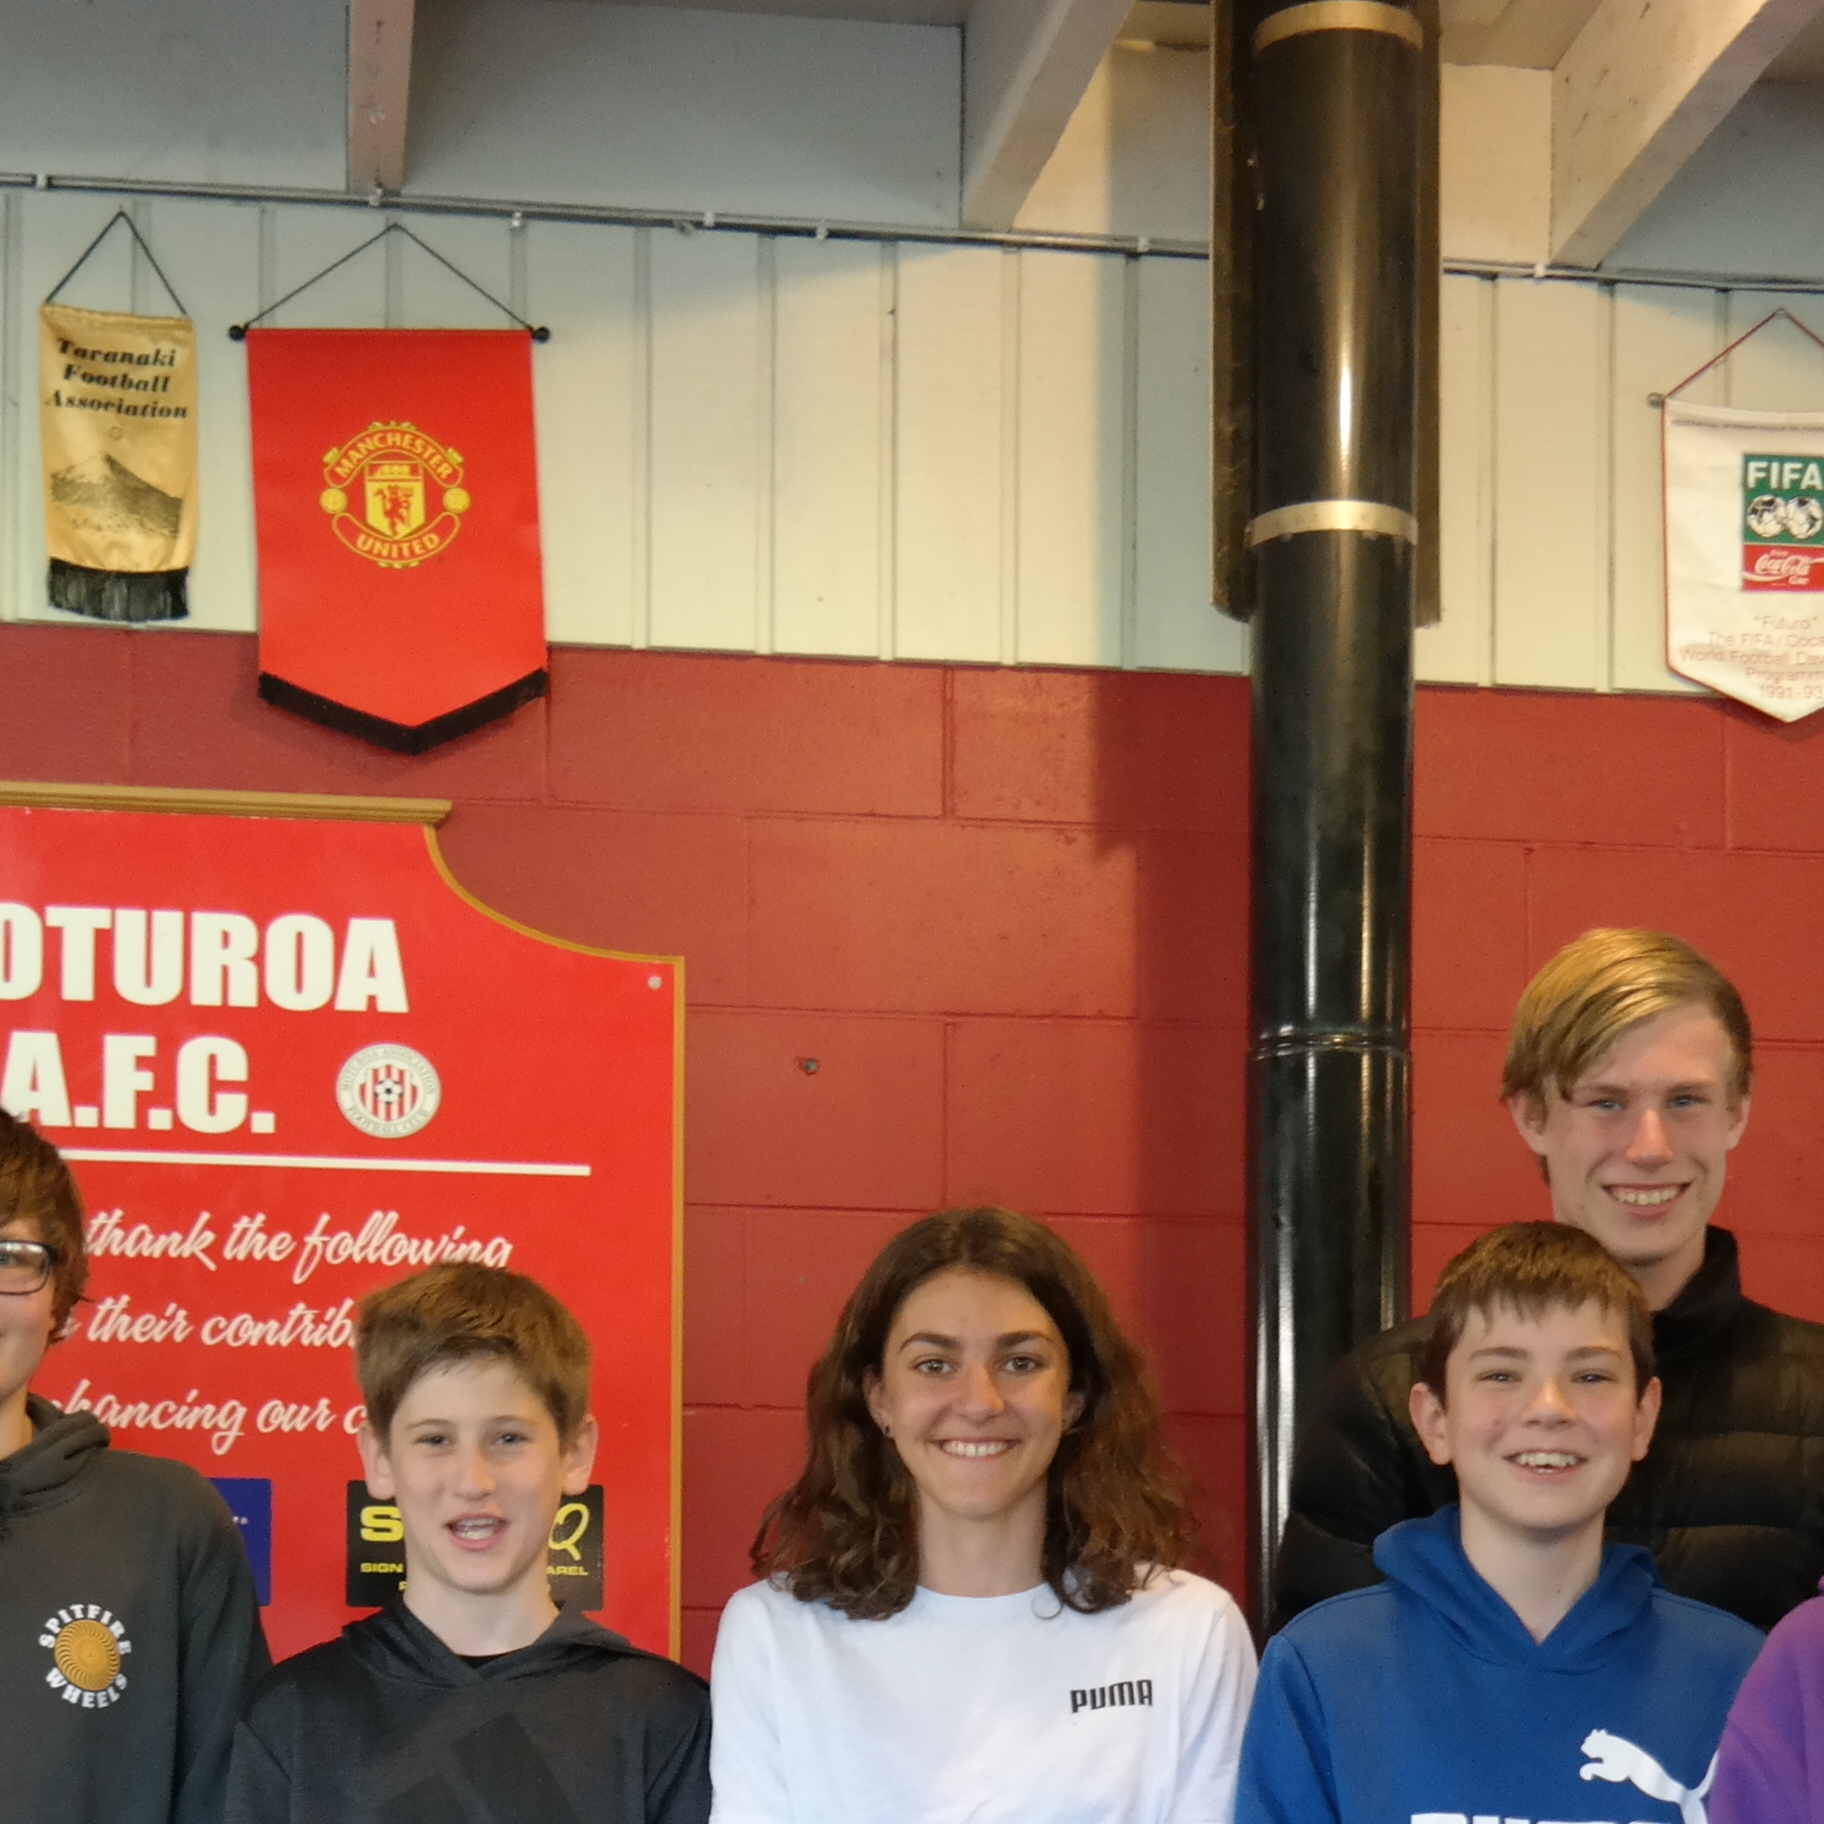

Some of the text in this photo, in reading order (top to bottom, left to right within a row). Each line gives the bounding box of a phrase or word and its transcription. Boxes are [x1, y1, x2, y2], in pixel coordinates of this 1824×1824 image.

[57, 336, 177, 367] Taranaki
[63, 363, 171, 393] Football
[45, 389, 188, 419] Association
[334, 432, 453, 479] MANCHESTER
[1746, 461, 1824, 490] FIFA
[356, 532, 440, 558] UNITED
[1678, 647, 1725, 662] World
[1729, 649, 1785, 664] Football
[1709, 631, 1735, 646] The
[0, 1030, 276, 1134] A.F.C.
[86, 1208, 218, 1272] thank
[222, 1212, 296, 1262] the
[292, 1209, 514, 1285] following
[87, 1294, 194, 1343] their
[256, 1397, 336, 1434] our
[38, 1603, 132, 1655] SPITFIRE
[45, 1666, 128, 1709] WHEELS
[1069, 1679, 1153, 1714] PUMA
